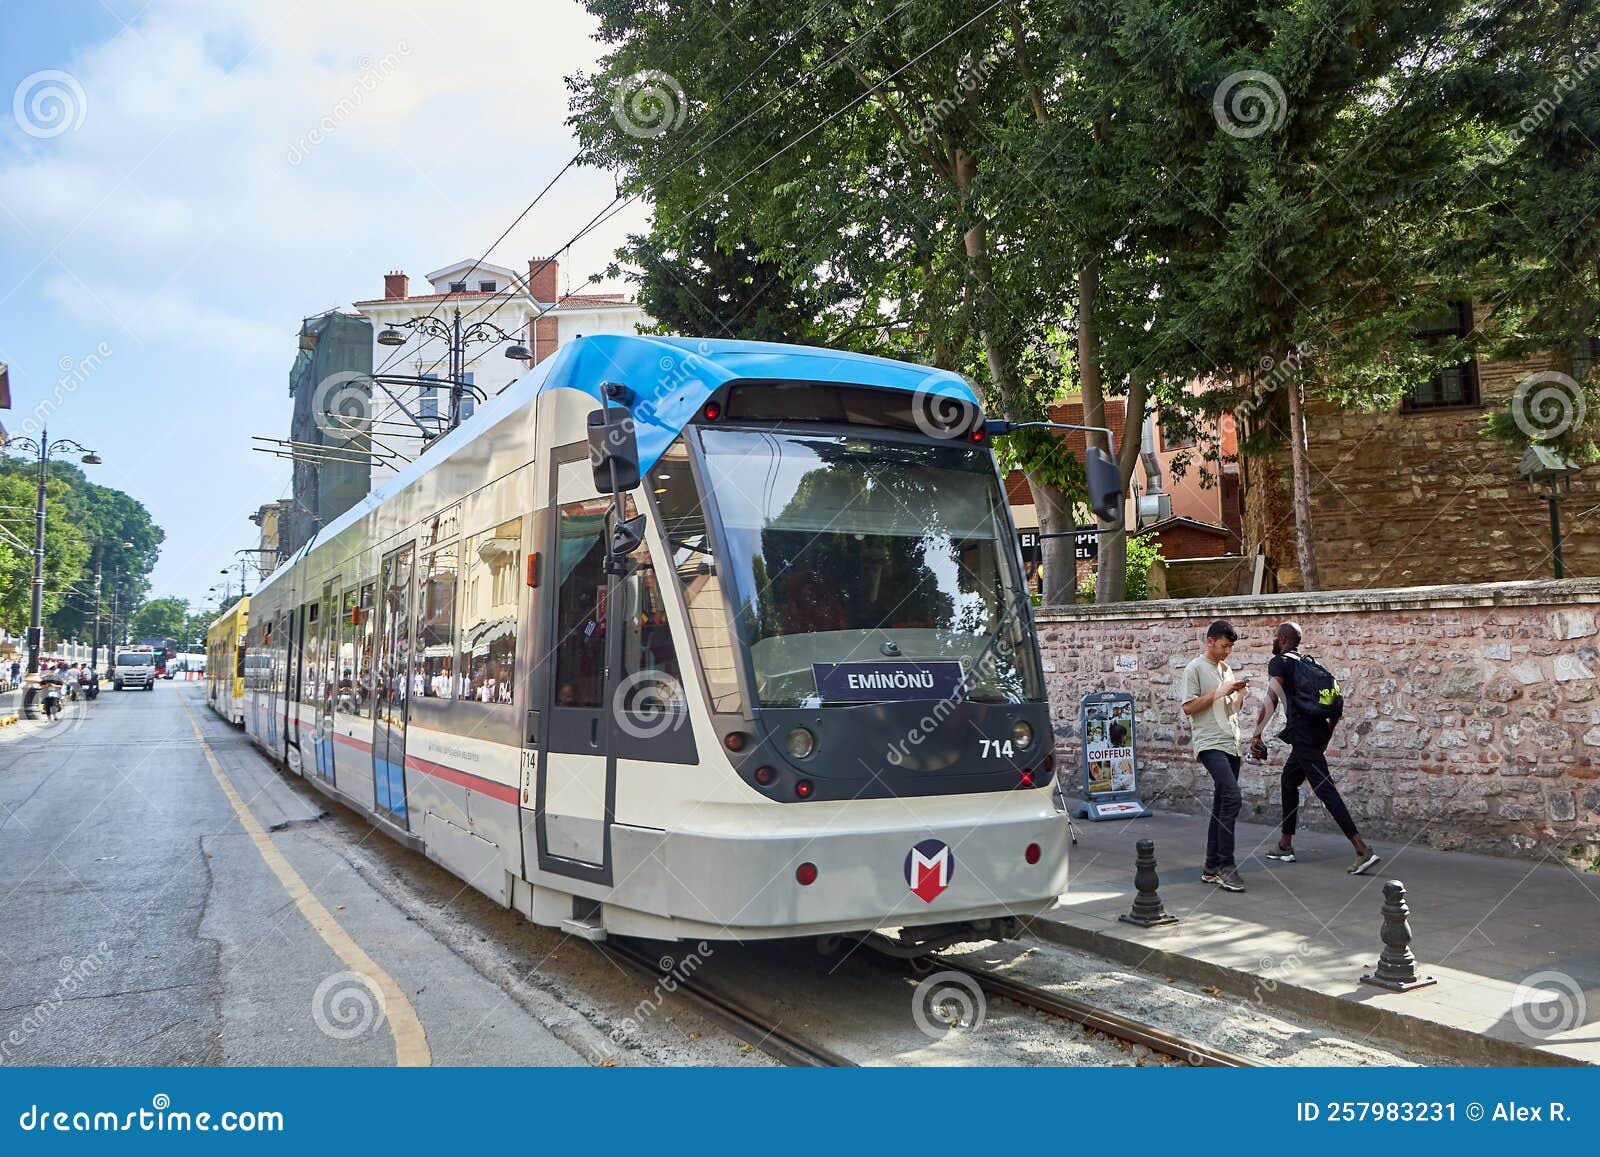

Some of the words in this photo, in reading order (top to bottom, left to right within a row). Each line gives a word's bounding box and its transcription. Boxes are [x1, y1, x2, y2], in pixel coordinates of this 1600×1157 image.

[848, 671, 934, 689] EMİNÖNÜ
[979, 739, 1015, 759] 714
[1089, 749, 1132, 760] COIFFEUR
[523, 751, 536, 769] 714
